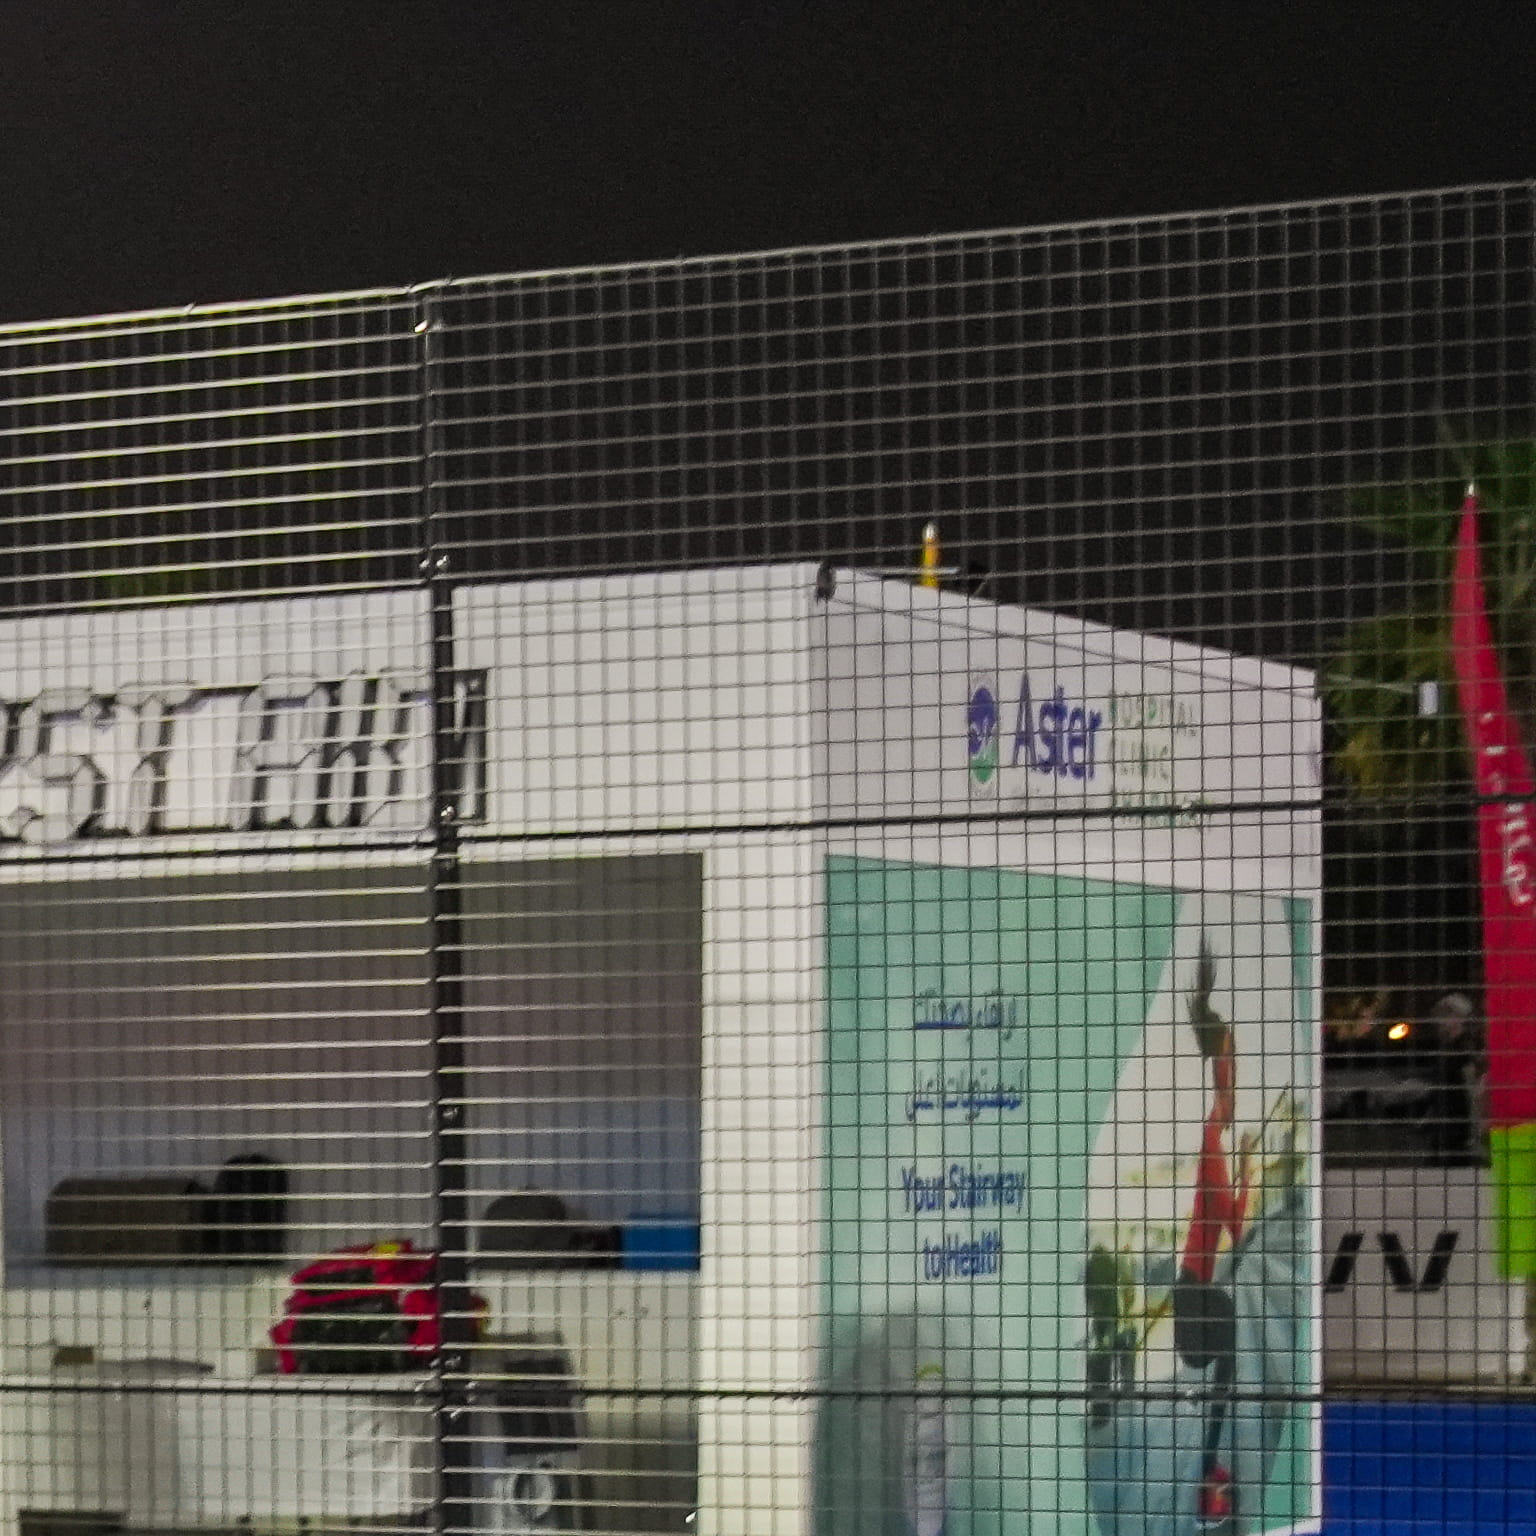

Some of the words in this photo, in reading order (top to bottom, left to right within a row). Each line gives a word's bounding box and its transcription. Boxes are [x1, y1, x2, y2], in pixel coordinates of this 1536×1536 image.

[1011, 670, 1102, 782] Aster
[901, 1164, 945, 1213] Your
[947, 1162, 1026, 1214] Stairway
